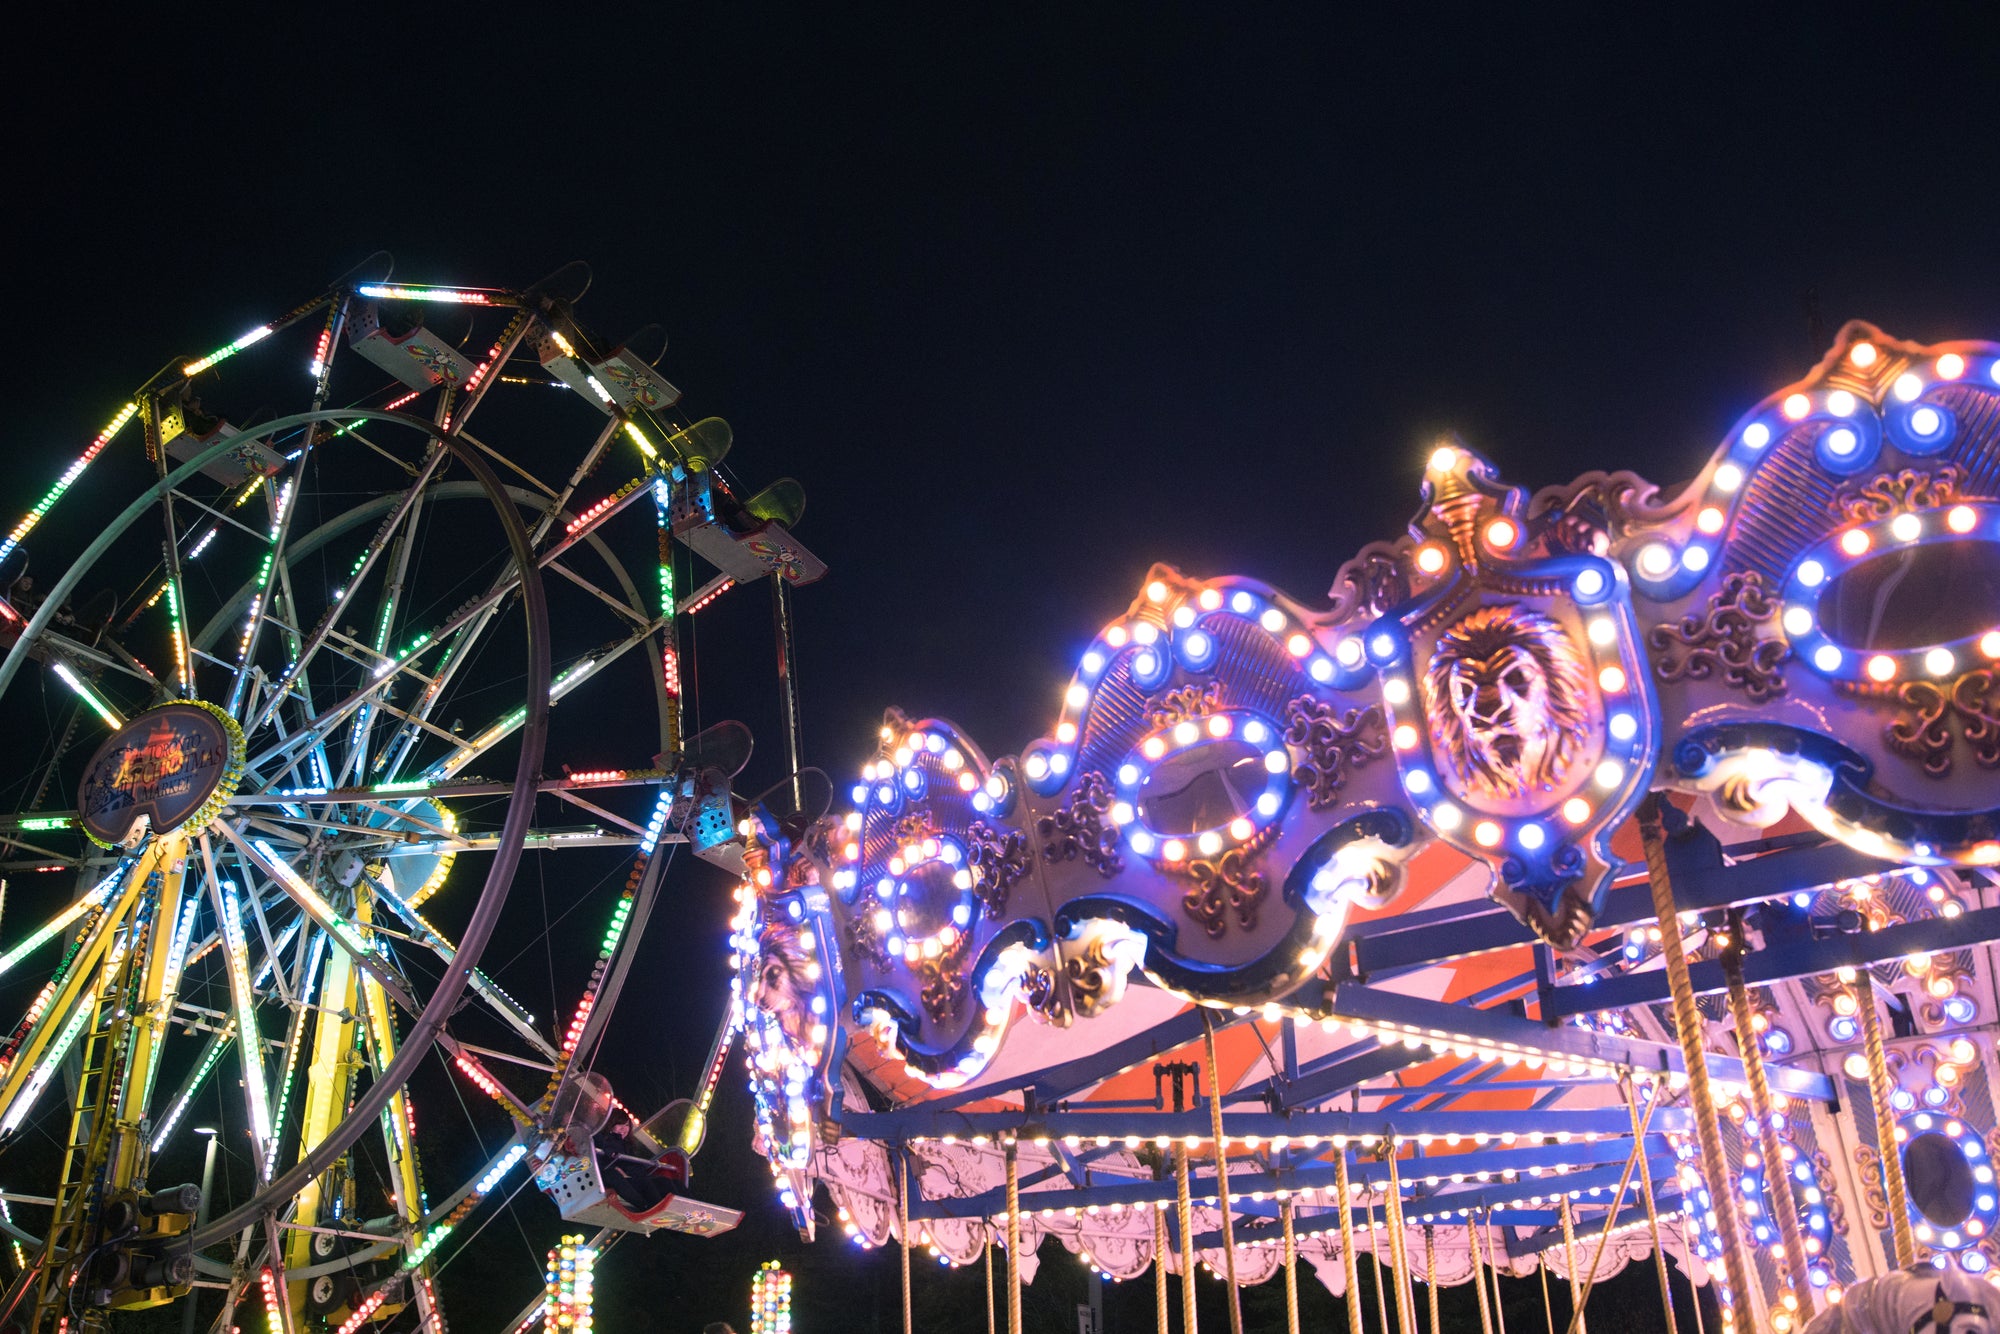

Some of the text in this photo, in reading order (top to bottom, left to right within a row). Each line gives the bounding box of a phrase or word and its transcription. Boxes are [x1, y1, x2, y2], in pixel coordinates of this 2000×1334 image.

[148, 734, 201, 760] TORONTO
[142, 745, 223, 784] CHRISTMAS
[142, 775, 192, 802] MARKET
